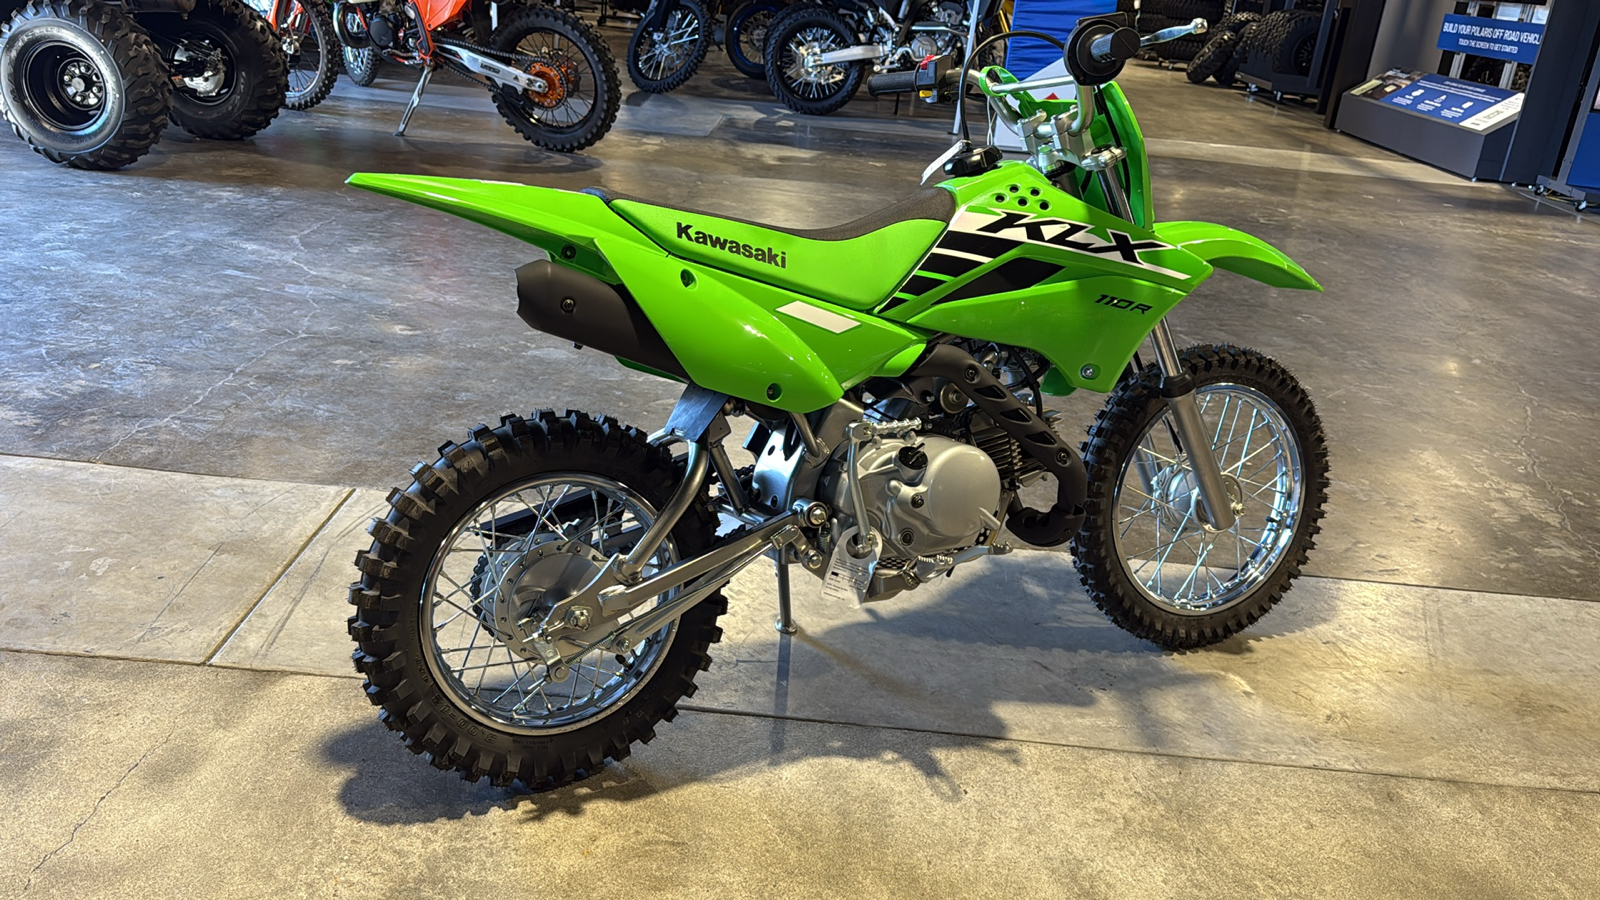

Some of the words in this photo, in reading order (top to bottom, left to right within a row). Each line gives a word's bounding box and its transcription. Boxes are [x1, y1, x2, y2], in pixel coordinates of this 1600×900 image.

[1443, 22, 1458, 34] BUILD
[1458, 24, 1471, 35] YOUR
[1471, 25, 1493, 38] POLARIS
[1492, 28, 1504, 40] OFF
[1503, 29, 1520, 42] ROAD
[1519, 32, 1542, 45] VEHICL
[676, 221, 787, 269] Kawasaki
[975, 210, 1168, 265] KLX
[1095, 294, 1153, 315] 110R
[432, 693, 497, 744] 3.00-12
